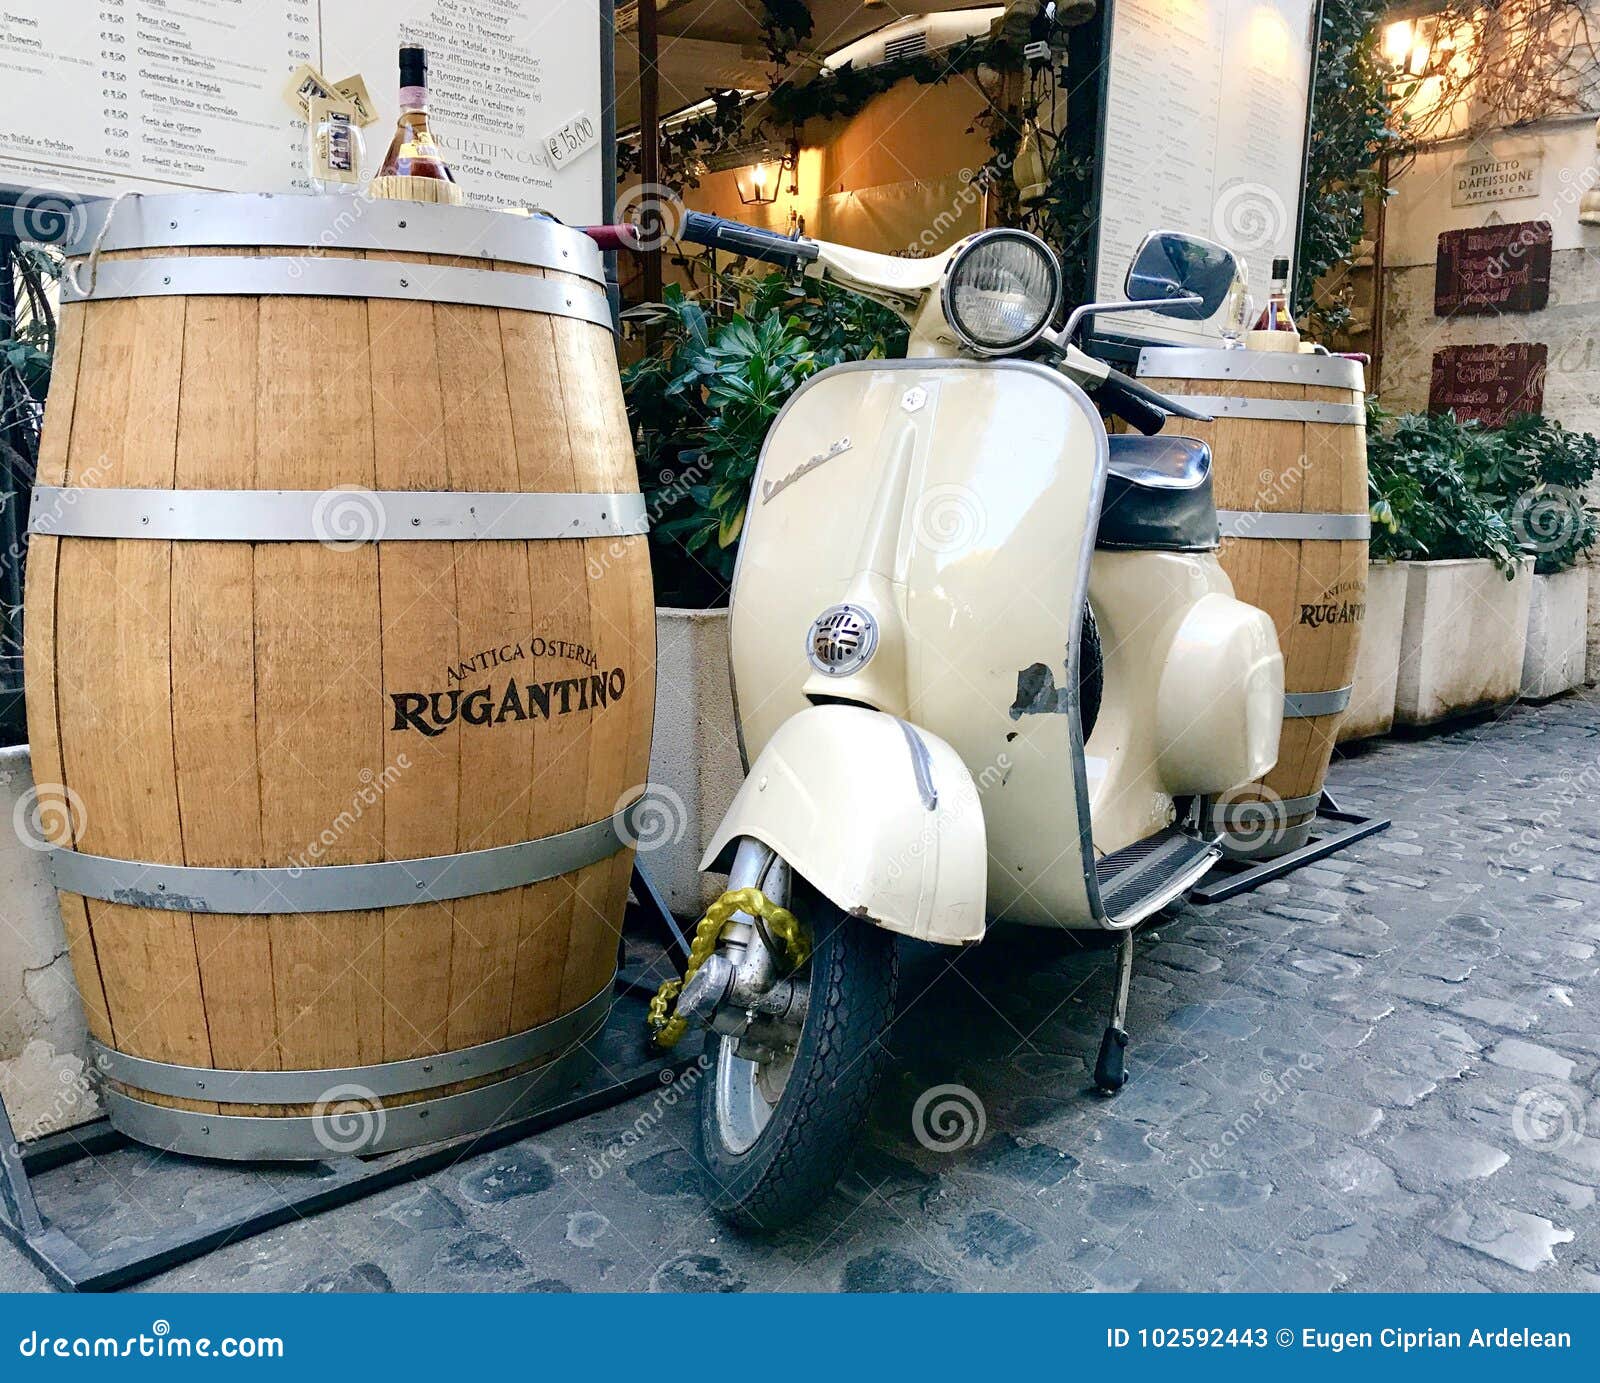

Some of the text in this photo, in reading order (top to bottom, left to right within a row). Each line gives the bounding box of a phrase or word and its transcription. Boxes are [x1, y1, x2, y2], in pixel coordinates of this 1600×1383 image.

[1458, 170, 1534, 190] D'AFFISSIONE
[1470, 160, 1519, 176] DIVIETO
[447, 637, 599, 687] ANTICA OSTERIA
[390, 667, 626, 737] RUGANTINO
